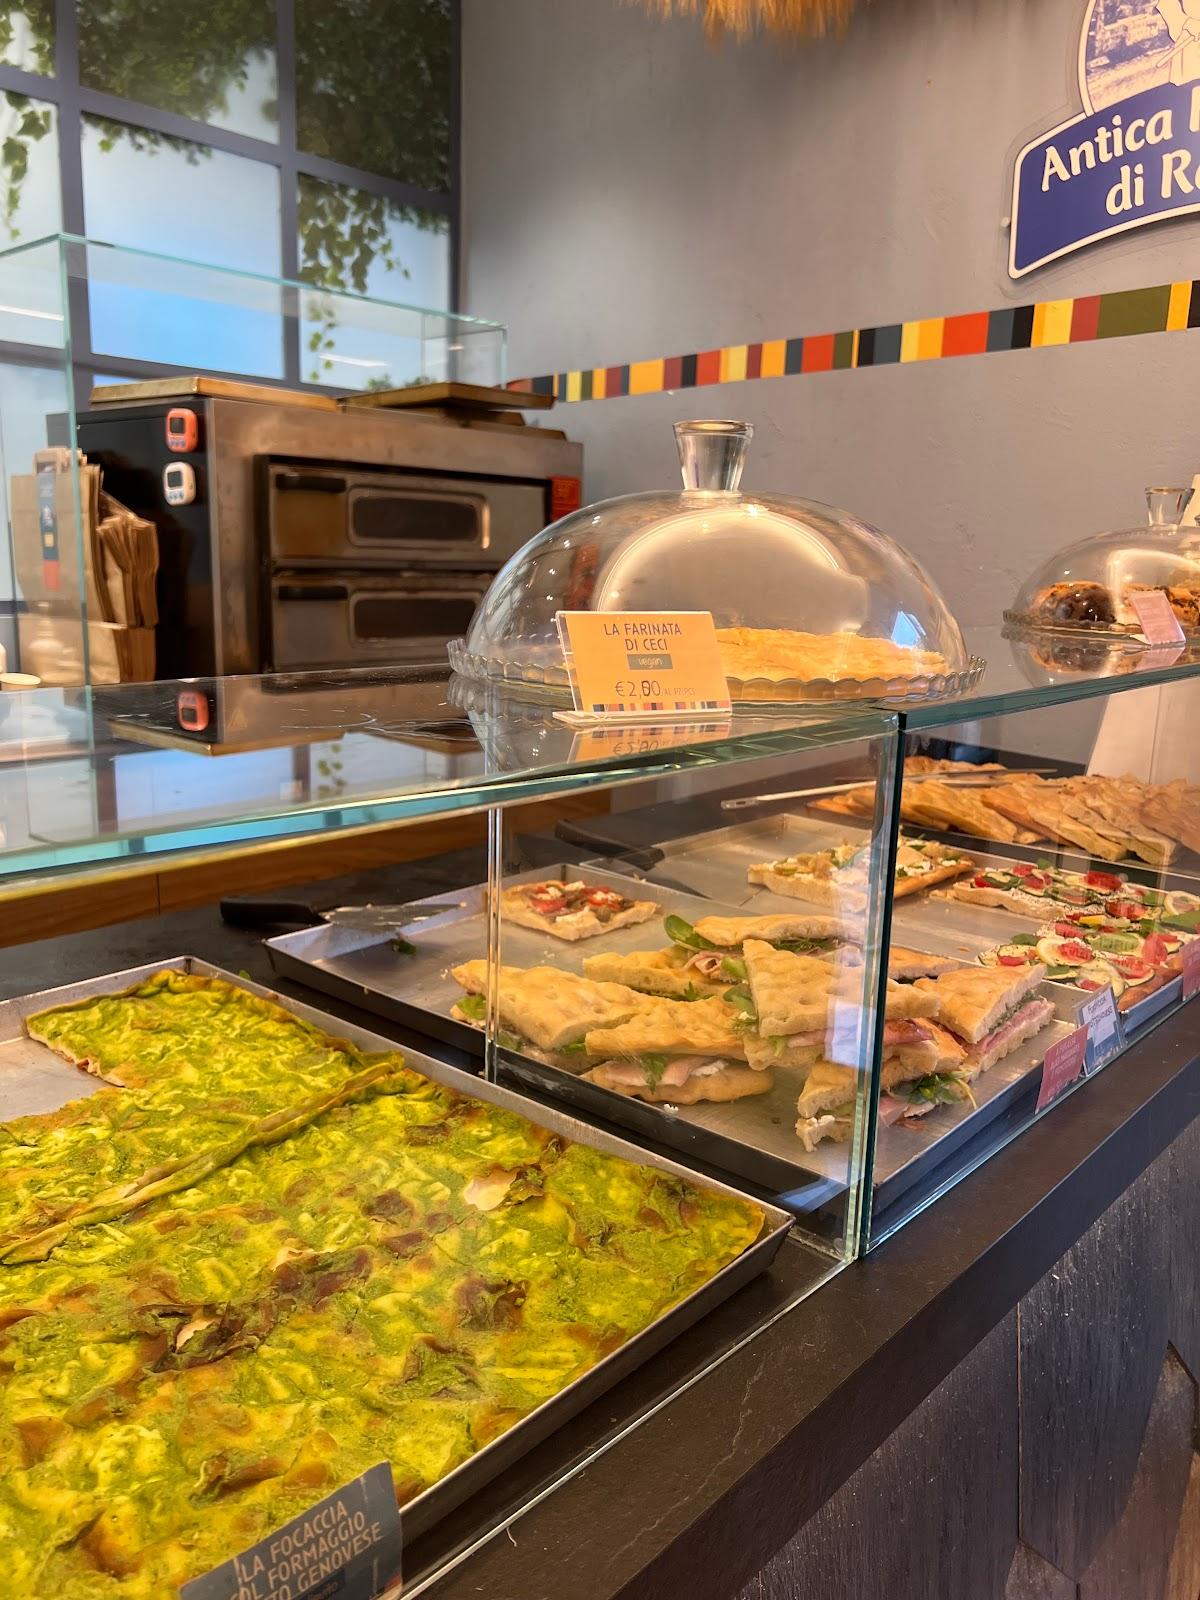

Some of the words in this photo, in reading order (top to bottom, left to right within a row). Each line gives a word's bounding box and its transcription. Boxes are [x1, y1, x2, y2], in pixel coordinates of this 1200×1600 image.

[1041, 109, 1174, 192] Antica
[1105, 163, 1144, 216] di
[604, 623, 620, 636] LA
[624, 623, 682, 636] FARINATA
[624, 638, 639, 651] DI
[643, 638, 668, 651] CECI
[638, 657, 663, 669] vegan
[240, 1555, 265, 1584] LA
[270, 1500, 348, 1564] FOCACCIA
[267, 1512, 365, 1590] FORMAGGIO
[297, 1521, 384, 1593] GENOVESE
